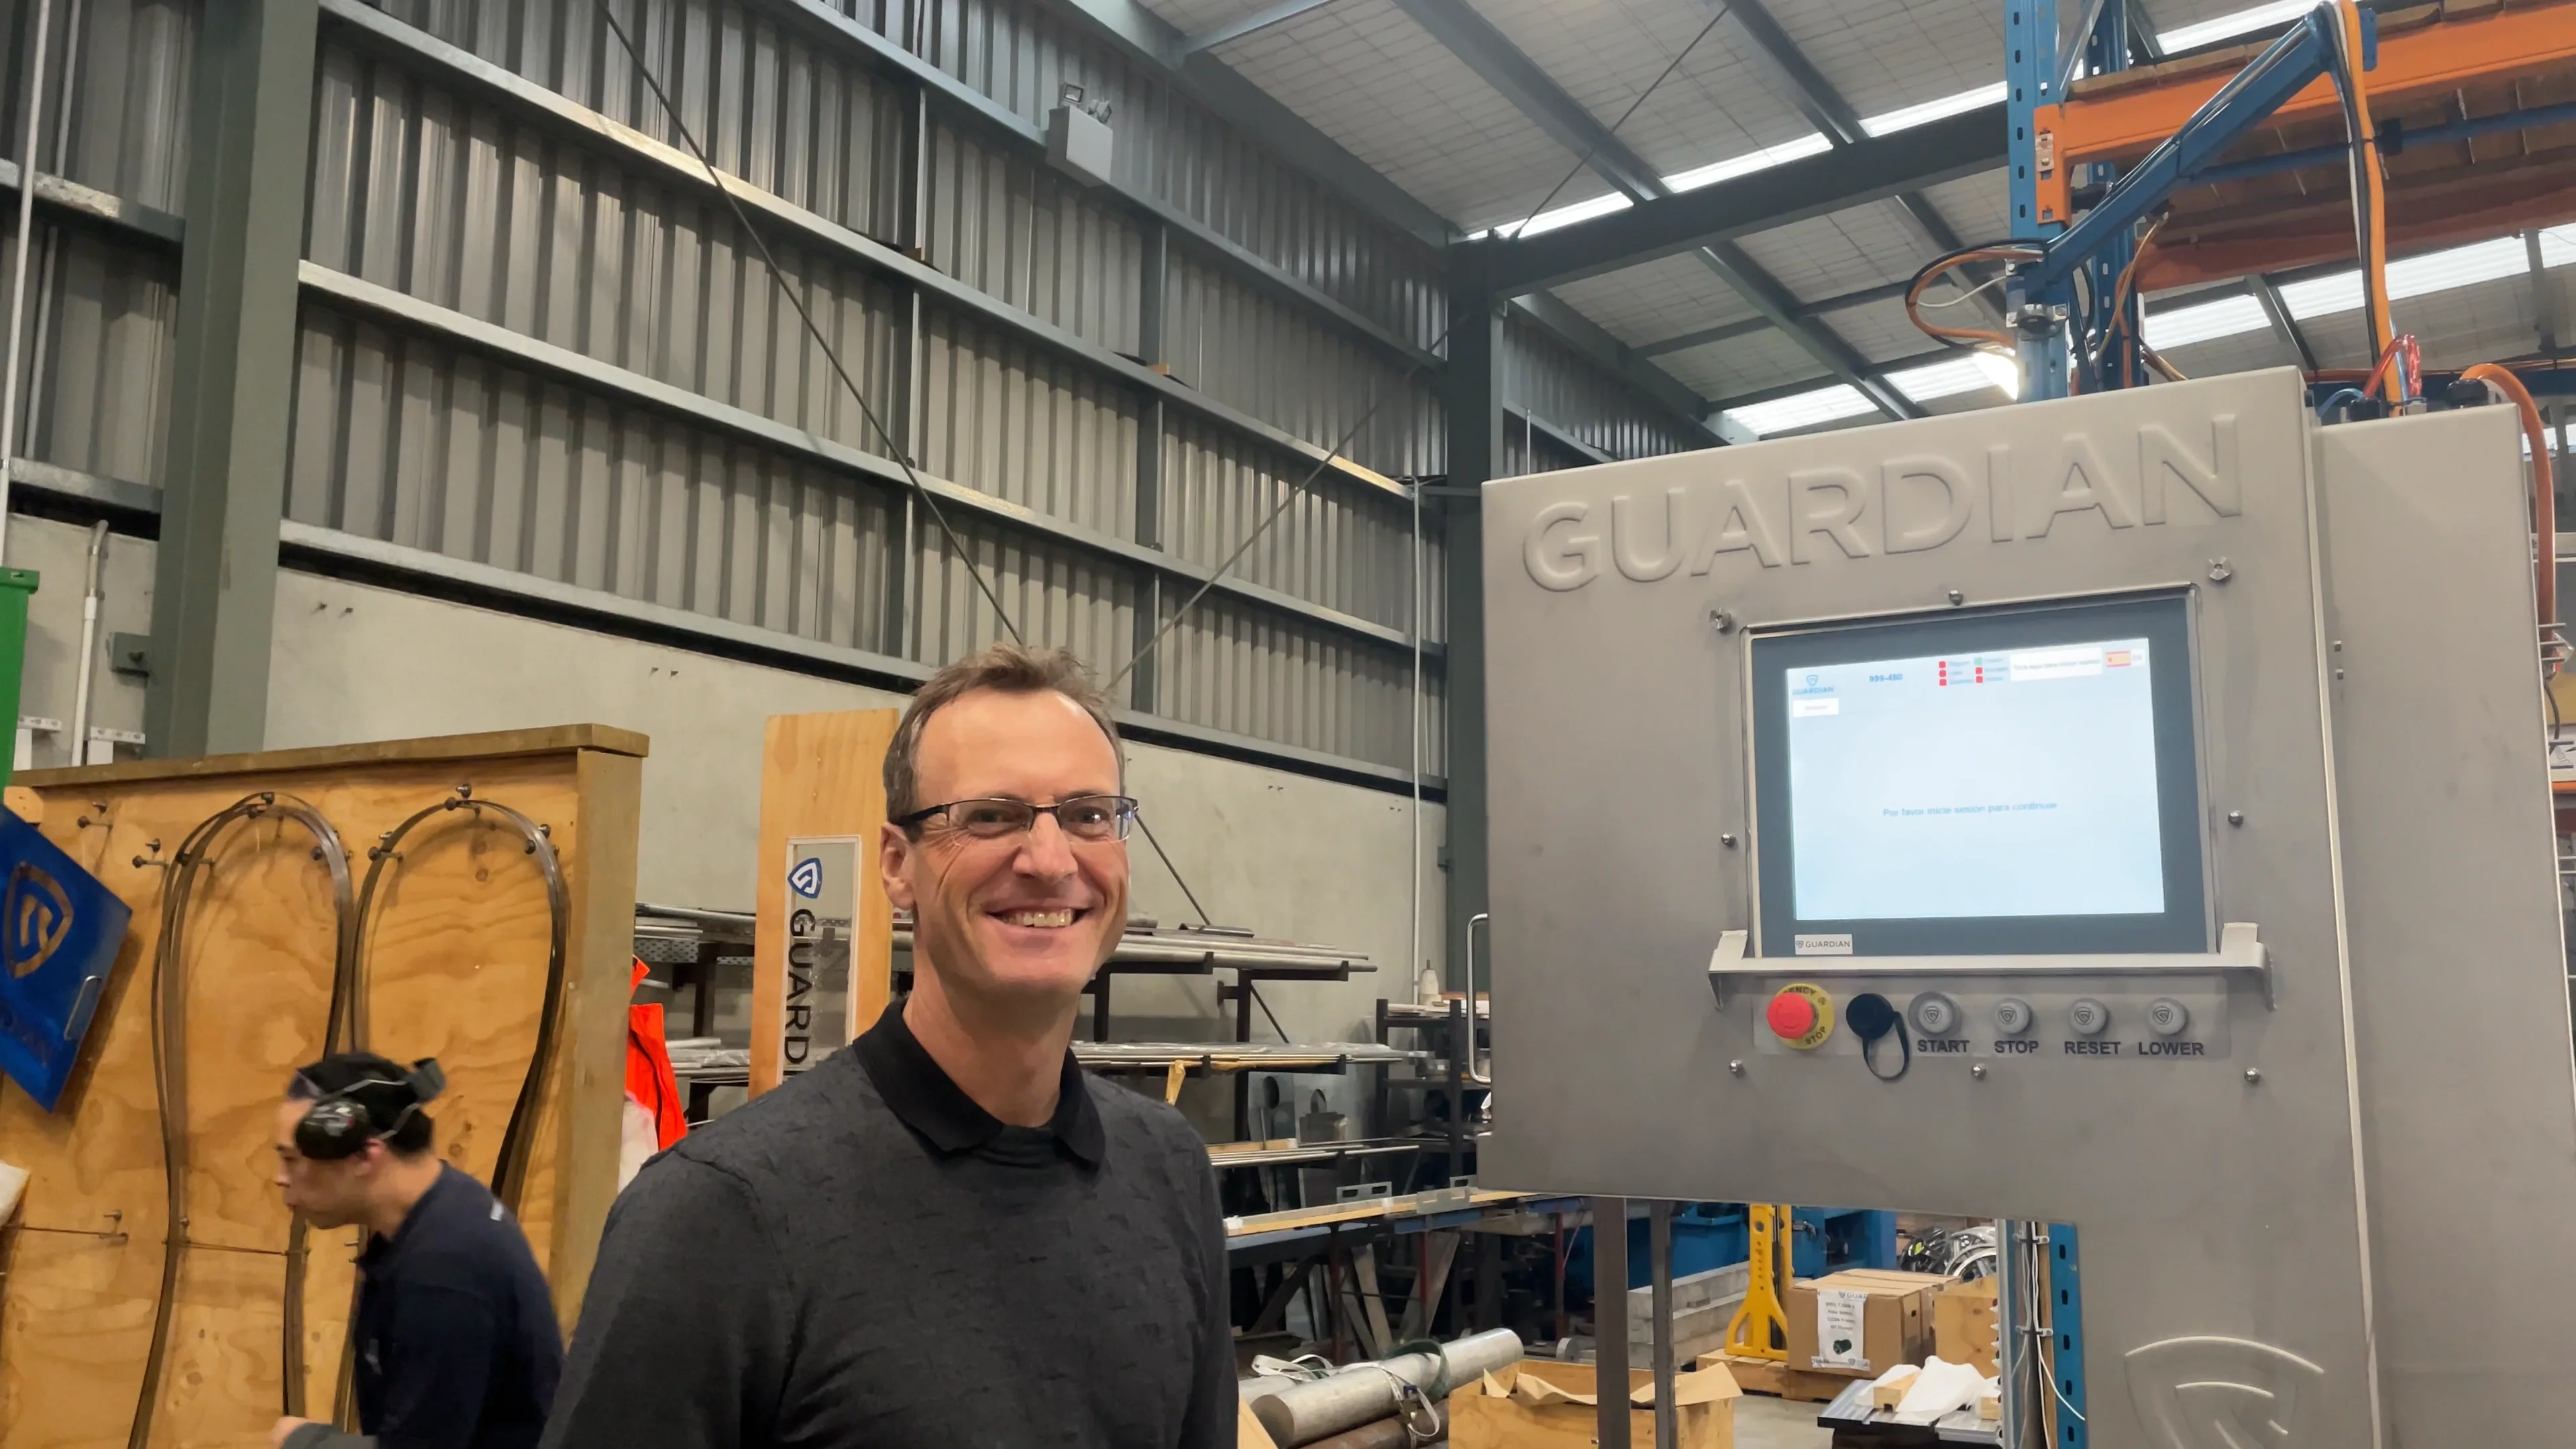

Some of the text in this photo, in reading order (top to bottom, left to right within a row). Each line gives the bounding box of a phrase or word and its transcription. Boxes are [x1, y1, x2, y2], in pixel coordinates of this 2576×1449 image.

[1523, 413, 2243, 592] GUARDIAN
[1883, 808, 1899, 817] Por
[1901, 808, 1924, 816] favor
[1988, 804, 2010, 813] para
[783, 908, 816, 1065] GUARD
[1805, 1026, 1826, 1044] STOP
[1917, 1039, 1970, 1053] START
[1994, 1040, 2039, 1054] STOP
[2064, 1040, 2121, 1055] RESET
[2138, 1041, 2204, 1056] LOWER
